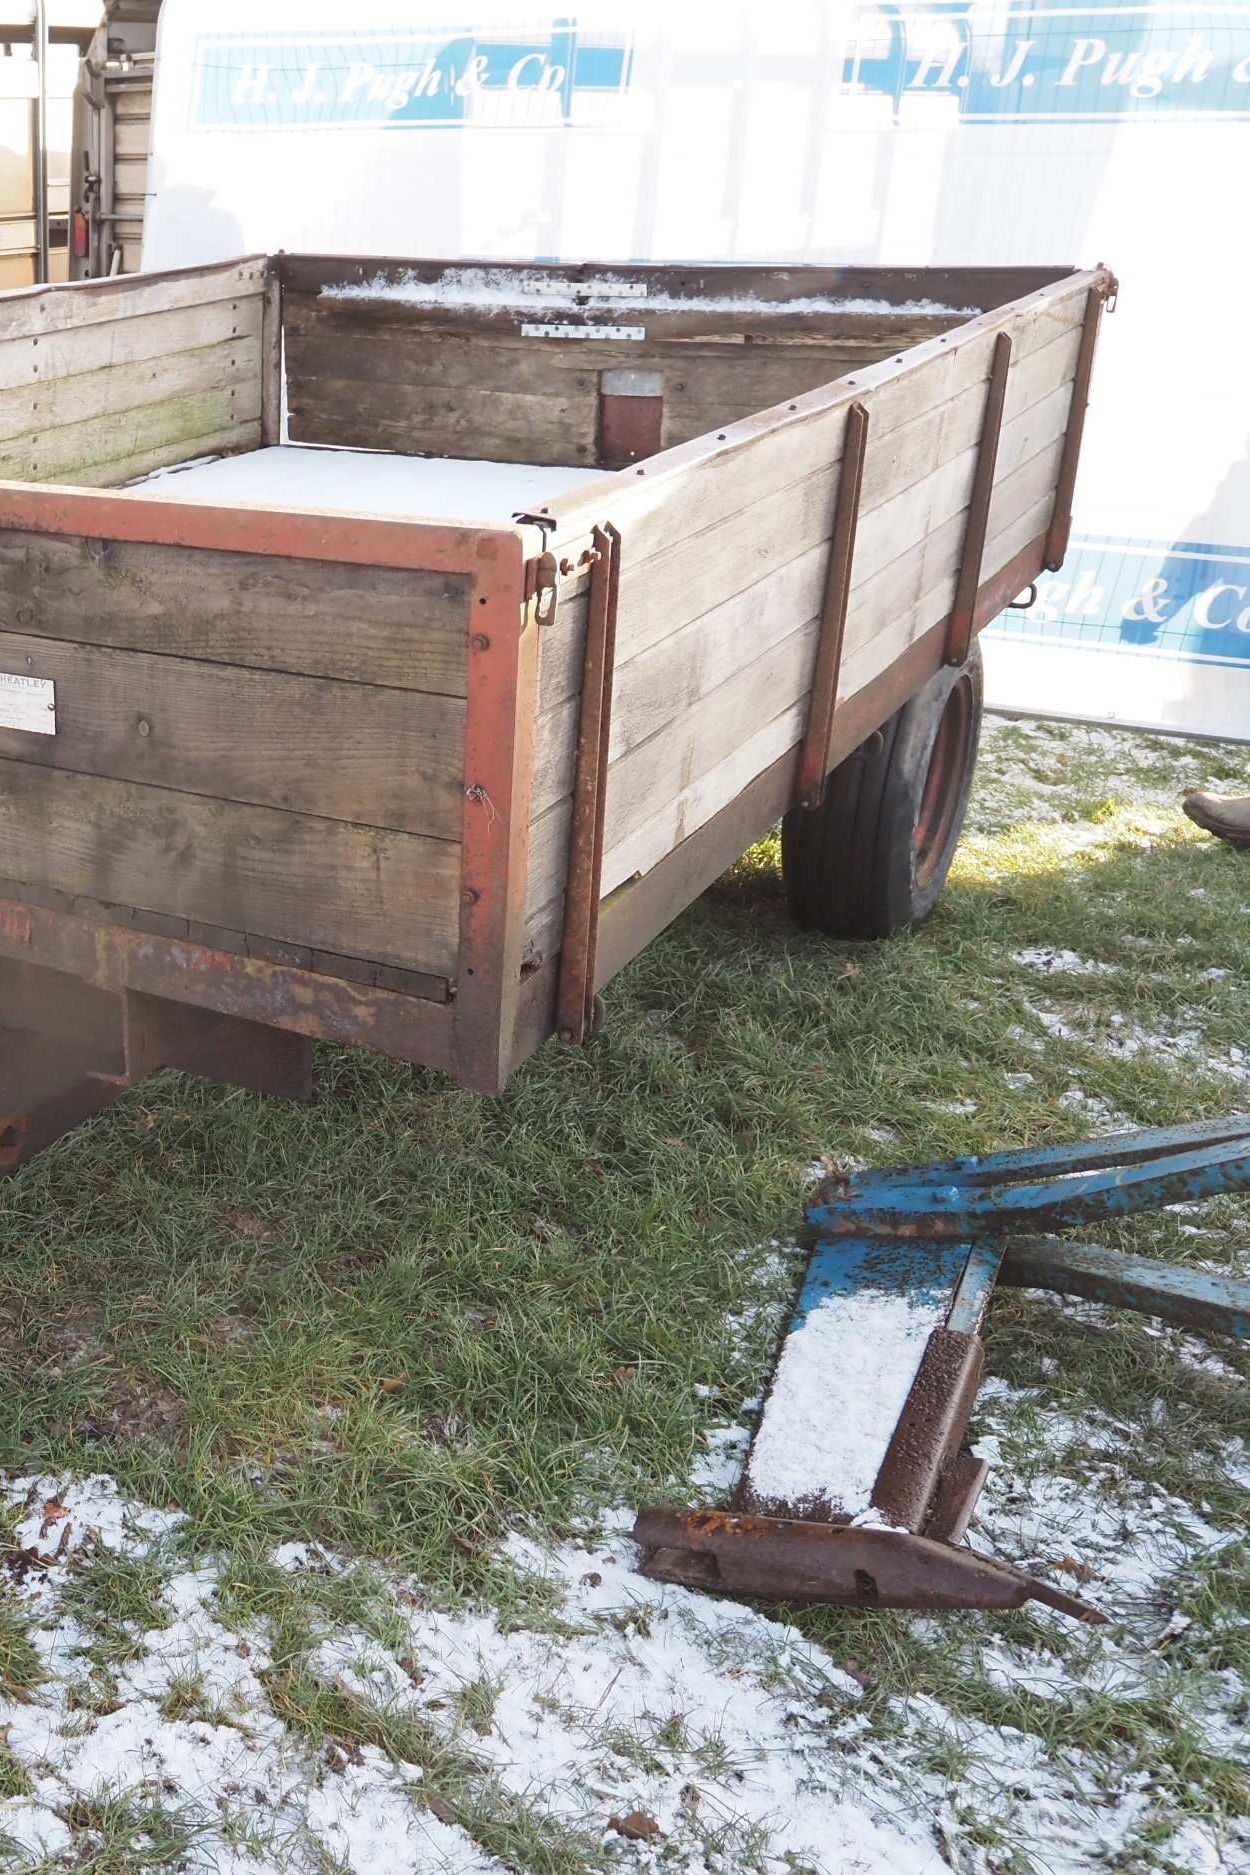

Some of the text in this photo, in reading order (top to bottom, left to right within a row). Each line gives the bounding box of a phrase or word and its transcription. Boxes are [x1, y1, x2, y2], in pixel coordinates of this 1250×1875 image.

[231, 52, 566, 109] H. J. Pugh & Co
[905, 41, 970, 88] H.
[990, 40, 1037, 87] J.
[1054, 34, 1213, 99] Pugh
[1024, 570, 1105, 624] gh
[1121, 577, 1172, 624] &
